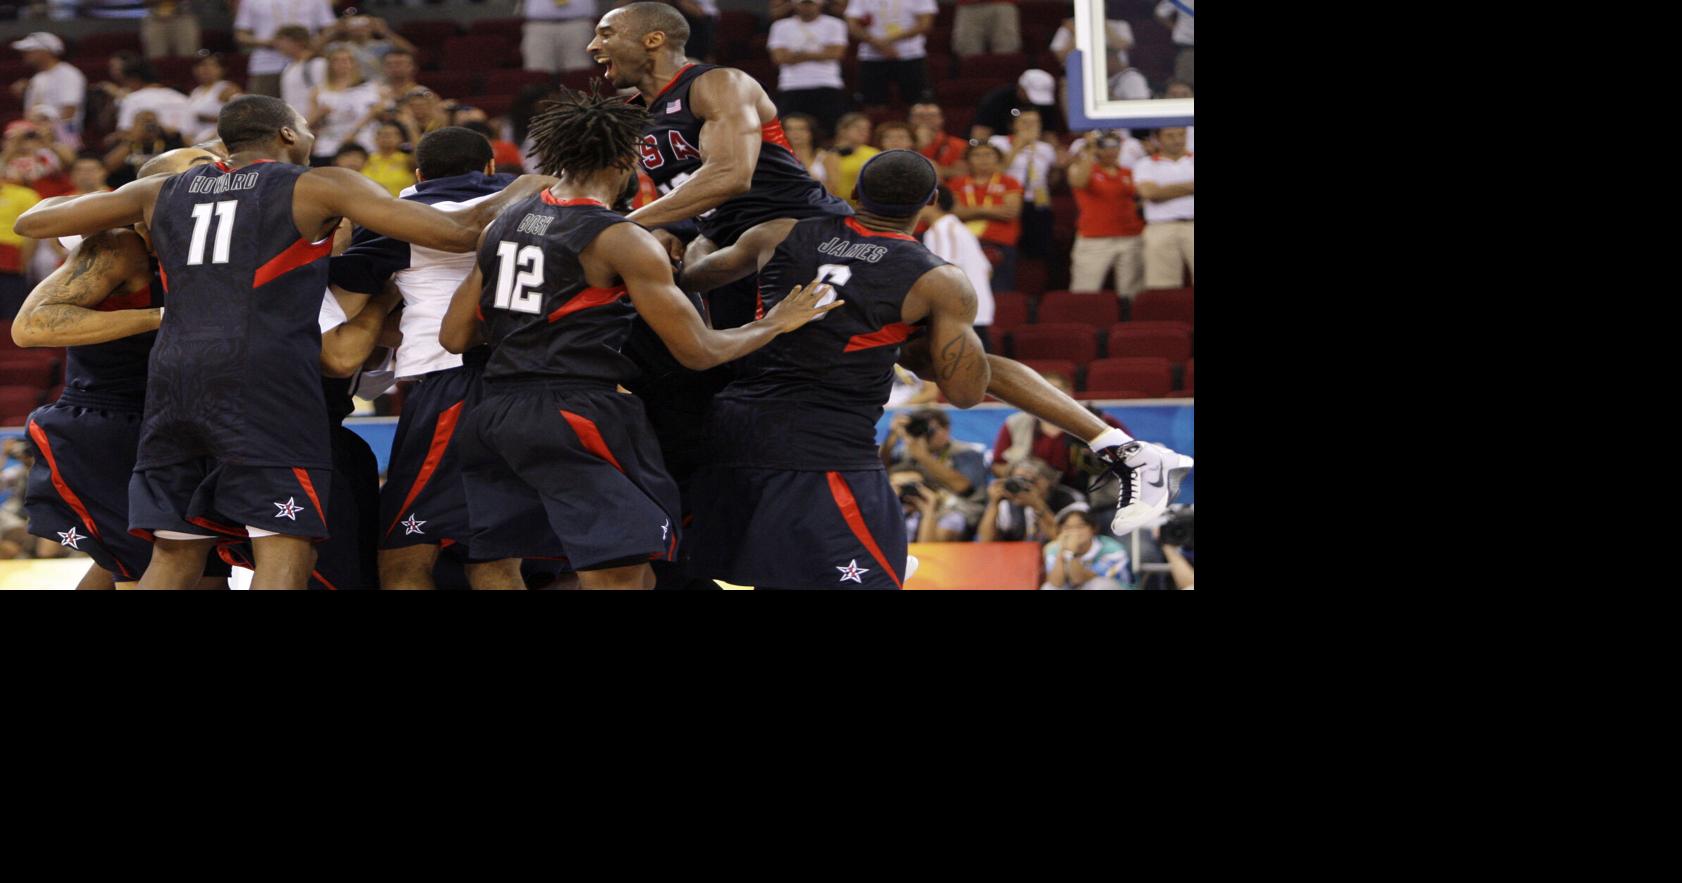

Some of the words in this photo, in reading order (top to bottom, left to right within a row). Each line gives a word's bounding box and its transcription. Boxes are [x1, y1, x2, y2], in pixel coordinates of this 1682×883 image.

[640, 129, 701, 170] SA
[188, 171, 259, 194] HOWARD
[186, 199, 238, 266] 11
[516, 212, 555, 236] BOSH
[817, 236, 888, 263] JAMES
[493, 240, 545, 315] 12
